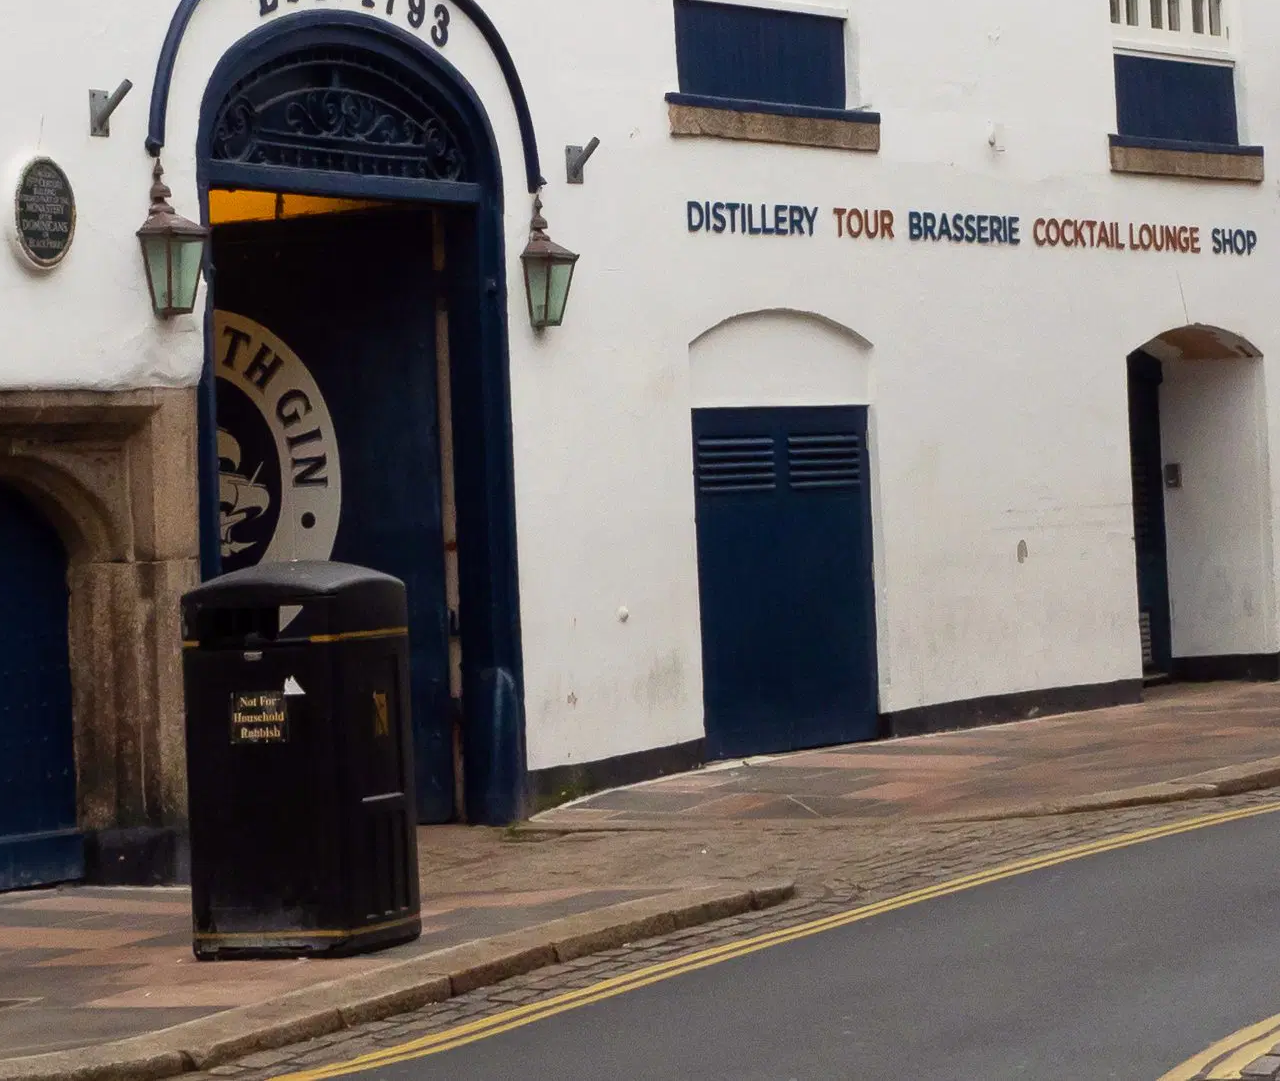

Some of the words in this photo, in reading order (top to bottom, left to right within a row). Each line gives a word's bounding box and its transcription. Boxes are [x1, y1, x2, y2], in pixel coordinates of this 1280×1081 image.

[686, 200, 819, 237] DISTILLERY
[832, 207, 895, 240] TOUR
[908, 210, 1021, 246] BRASSERIE
[1032, 217, 1125, 251] COCKTAIL
[1128, 223, 1201, 254] LOUNGE
[1211, 227, 1258, 256] SHOP
[275, 388, 329, 489] GIN
[239, 696, 257, 707] Not
[260, 695, 277, 707] For
[233, 711, 285, 723] Household
[240, 726, 281, 739] Rubbish
